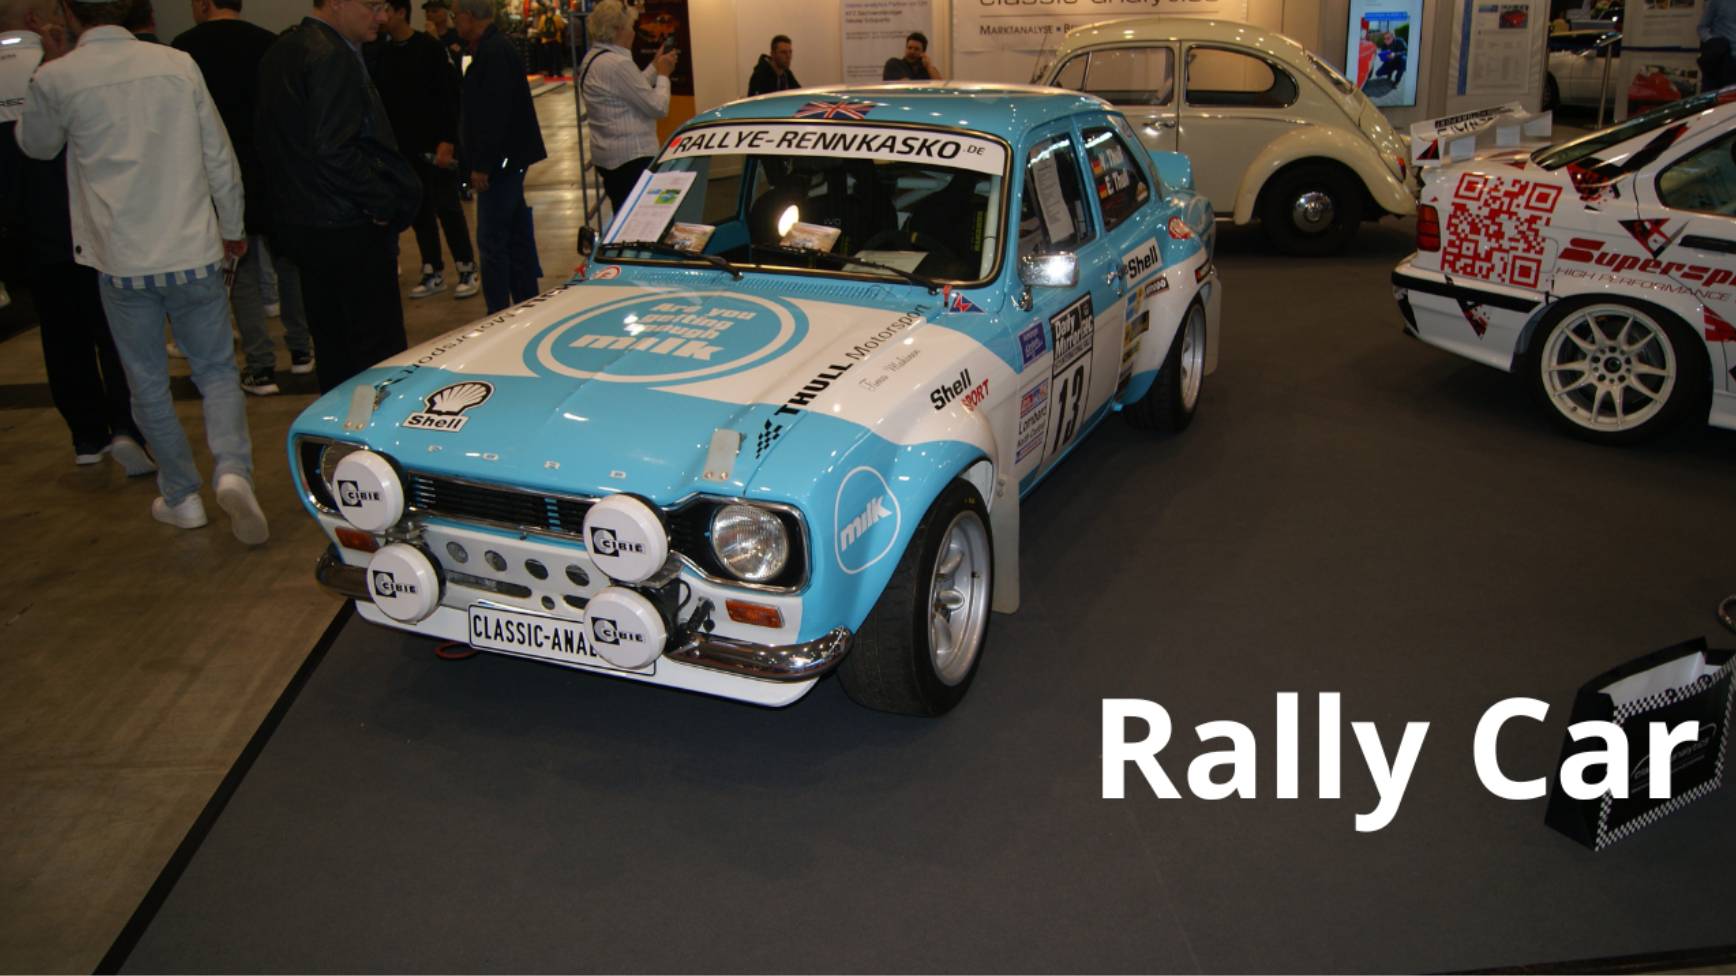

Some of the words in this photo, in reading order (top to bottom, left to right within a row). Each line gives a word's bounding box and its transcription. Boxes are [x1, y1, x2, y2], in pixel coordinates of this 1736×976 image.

[1127, 245, 1158, 279] Shell
[1558, 238, 1736, 287] Supersp
[638, 313, 735, 331] getting
[648, 302, 702, 312] Are
[705, 306, 757, 320] you
[569, 334, 725, 361] milk
[774, 361, 854, 417] THULL
[930, 369, 973, 411] Shell
[407, 415, 463, 429] Shell
[1052, 365, 1085, 453] 13
[839, 495, 893, 552] milk
